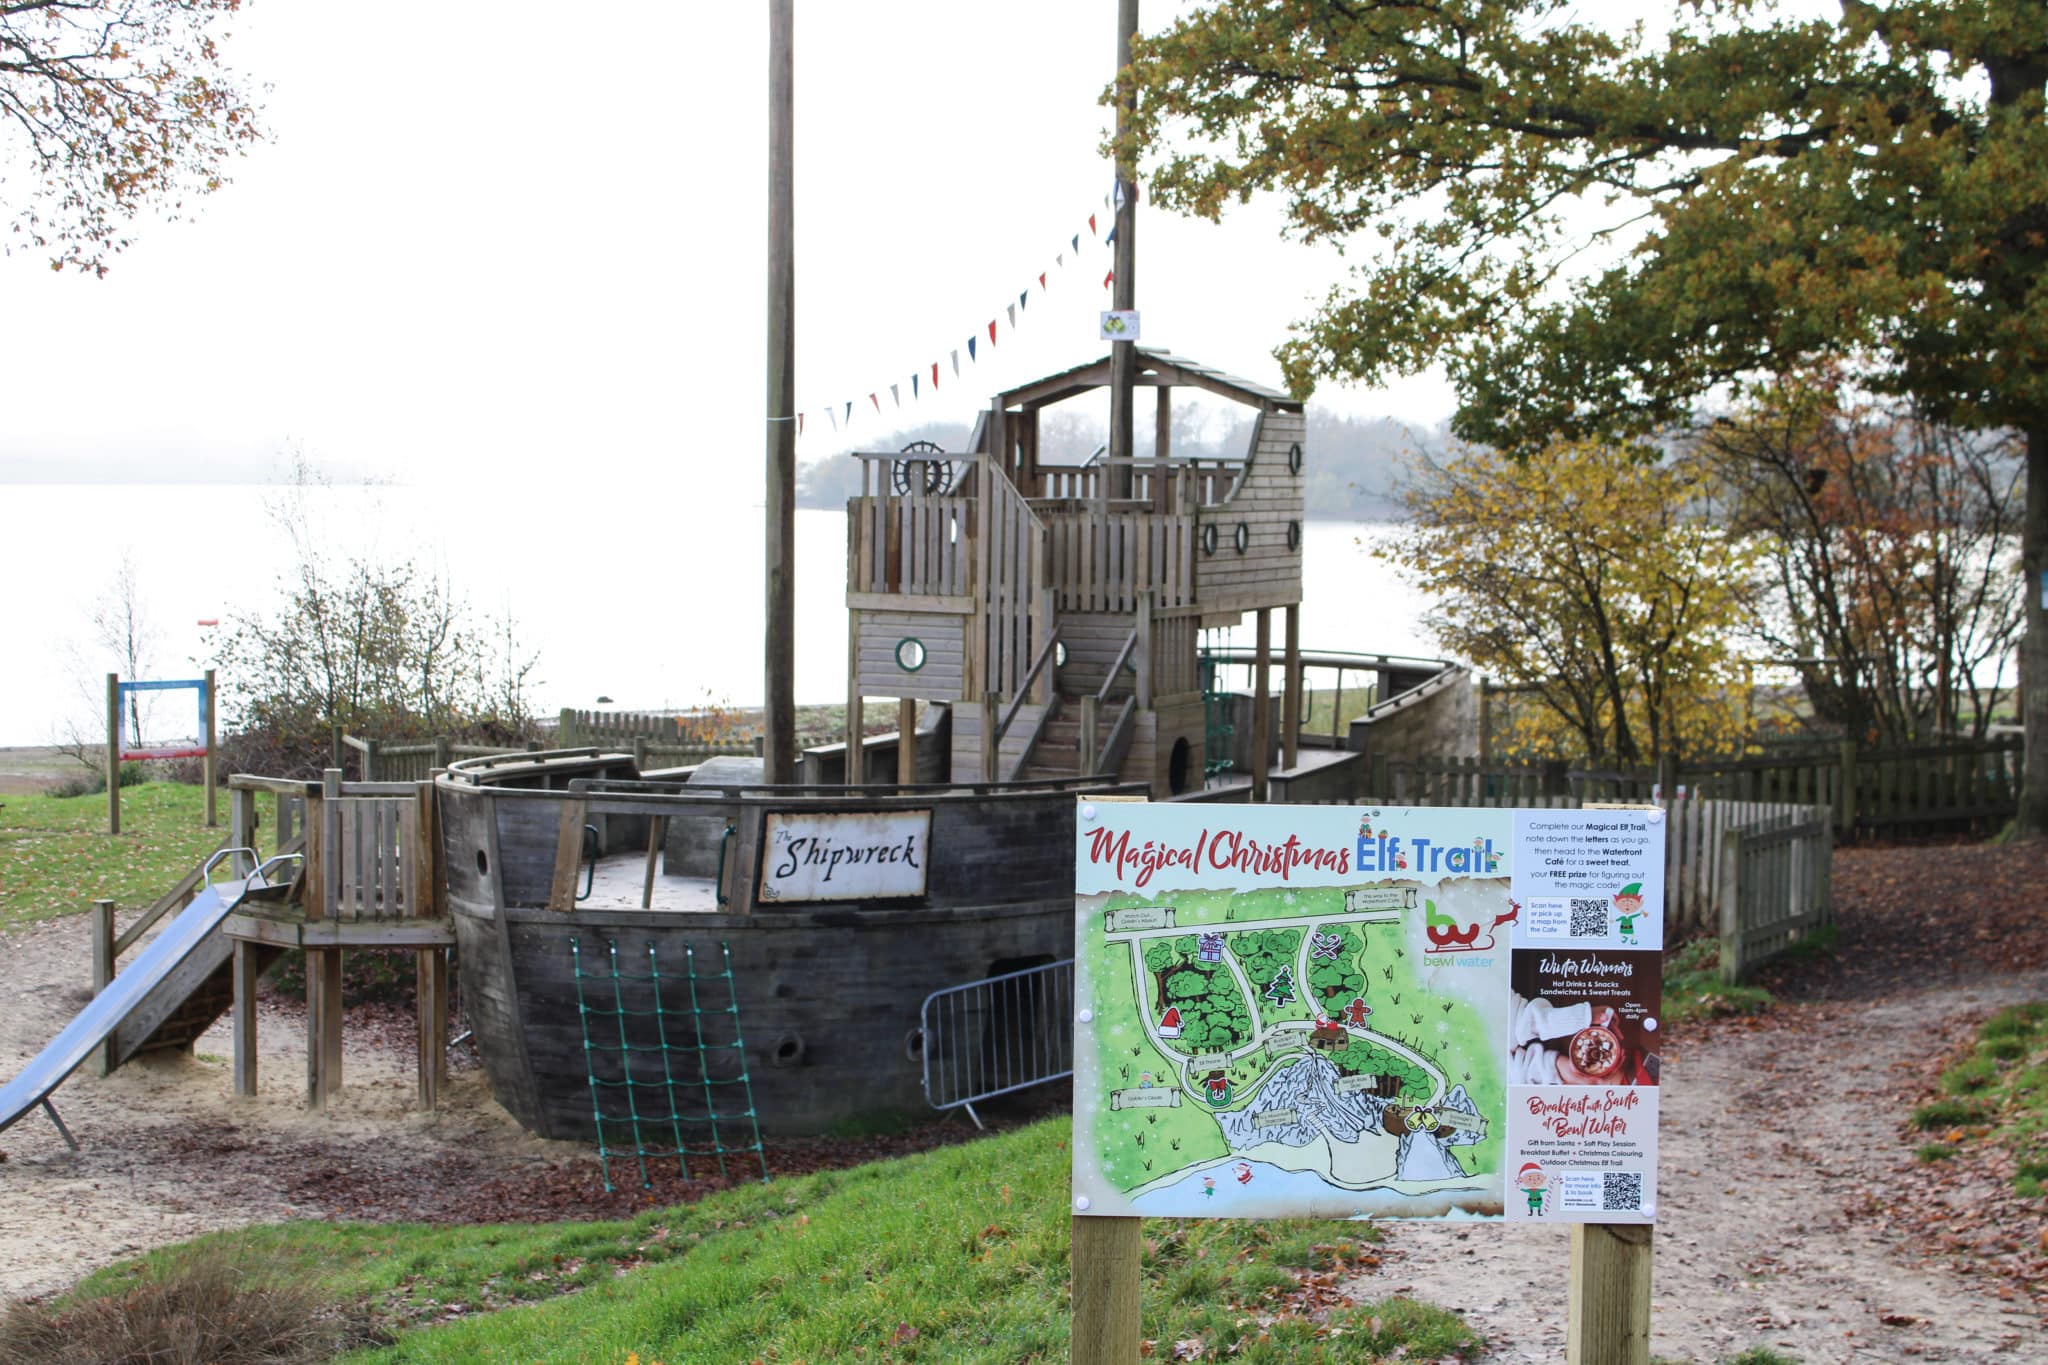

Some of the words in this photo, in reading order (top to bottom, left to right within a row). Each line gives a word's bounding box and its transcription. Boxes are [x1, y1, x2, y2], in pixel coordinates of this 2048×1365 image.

[1529, 822, 1569, 831] Complete
[1585, 823, 1618, 832] Magical
[775, 830, 793, 844] The
[1602, 848, 1642, 856] Waterfront
[775, 835, 920, 882] Shipwreck
[1085, 826, 1208, 888] Magical
[1208, 829, 1350, 881] Christmas
[1356, 836, 1400, 872] Elf
[1411, 838, 1493, 873] Trail
[1545, 857, 1565, 866] Café
[1566, 858, 1576, 866] for
[1586, 858, 1609, 866] sweet
[1568, 871, 1587, 879] prize
[1601, 871, 1630, 880] figuring
[1569, 881, 1594, 890] magic
[1596, 881, 1621, 889] code!
[1423, 954, 1455, 967] bewl
[1455, 956, 1496, 968] water
[1539, 952, 1579, 978] Winter
[1580, 952, 1633, 977] Warmers
[1552, 980, 1565, 988] Hot
[1565, 980, 1586, 988] Drinks
[1539, 988, 1581, 996] Sandwiches
[1526, 1094, 1590, 1117] Breakfast
[1586, 1099, 1602, 1112] with
[1603, 1089, 1639, 1111] Santa
[1542, 1116, 1552, 1131] at
[1552, 1115, 1589, 1138] Bewl
[1588, 1111, 1627, 1138] Water
[1597, 1140, 1610, 1148] Play
[1611, 1150, 1643, 1158] Colouring
